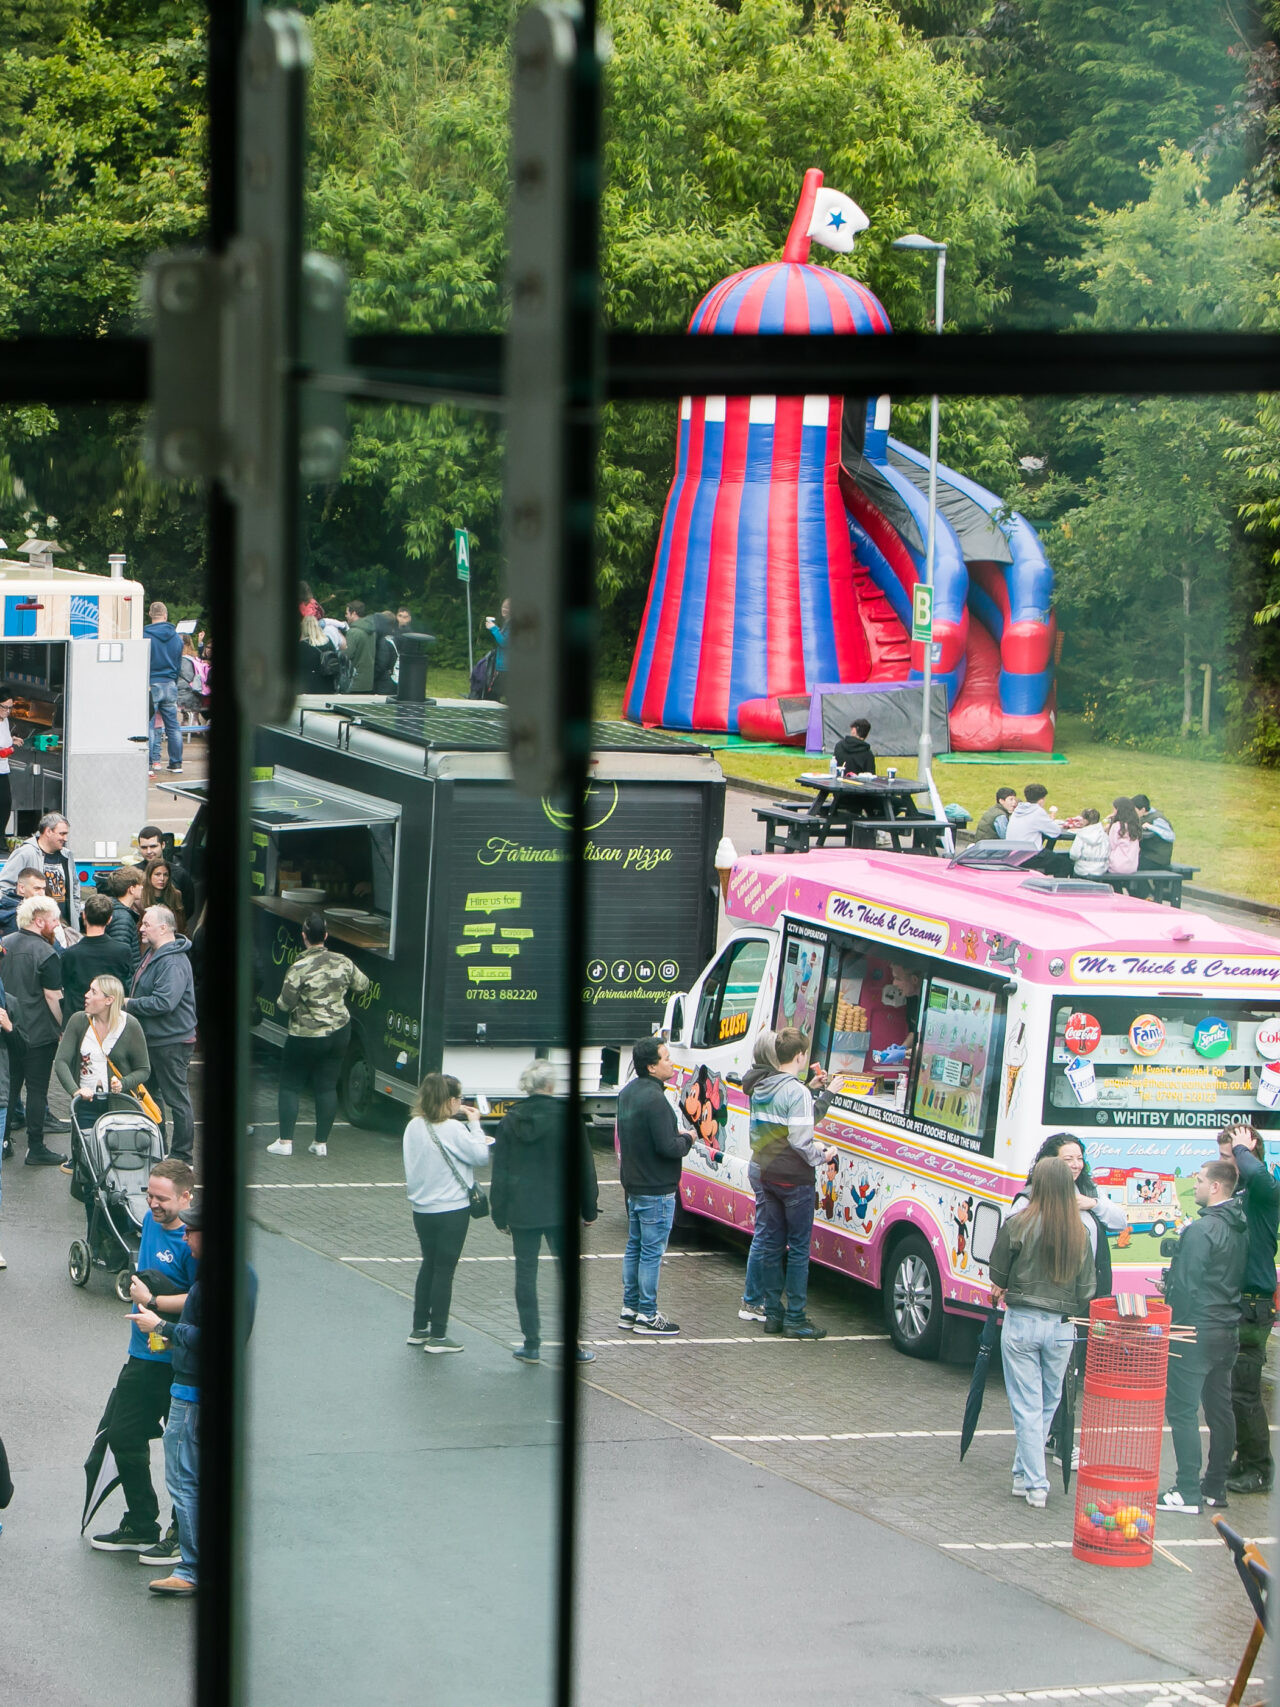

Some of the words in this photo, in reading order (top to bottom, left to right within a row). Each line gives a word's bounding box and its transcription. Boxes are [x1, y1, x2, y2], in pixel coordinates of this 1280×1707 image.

[457, 535, 469, 567] A
[915, 590, 931, 626] B
[622, 845, 674, 872] pizza
[470, 897, 489, 906] Hire
[490, 898, 501, 906] us
[503, 895, 517, 905] for
[833, 898, 855, 919] Mr
[857, 904, 885, 928] Thick
[887, 914, 897, 930] &
[898, 918, 943, 947] Creamy
[803, 928, 828, 941] OPERATION
[1077, 957, 1117, 974] Mr
[1122, 957, 1177, 974] Thick
[1180, 959, 1198, 974] &
[1203, 959, 1280, 981] Creamy
[466, 989, 496, 1000] 07783
[499, 989, 538, 1000] 882220
[719, 1011, 748, 1040] SLUSH
[1132, 1065, 1144, 1076] All
[1146, 1065, 1172, 1076] Events
[1175, 1066, 1209, 1077] Catered
[1212, 1066, 1226, 1078] For
[834, 1095, 843, 1107] DO
[842, 1098, 853, 1110] NOT
[852, 1101, 868, 1115] ALLOW
[882, 1112, 906, 1126] SCOOTERS
[906, 1119, 914, 1129] OR
[914, 1121, 923, 1133] PET
[923, 1124, 946, 1140] POOCHES
[946, 1131, 960, 1144] NEAR
[960, 1136, 970, 1148] THE
[969, 1139, 981, 1152] VAN
[1113, 1110, 1170, 1125] WHITBY
[1173, 1112, 1252, 1127] MORRISON
[895, 1146, 925, 1161] Cool
[1085, 1141, 1120, 1158] Often
[1126, 1143, 1168, 1156] Licked
[1175, 1143, 1217, 1156] Never
